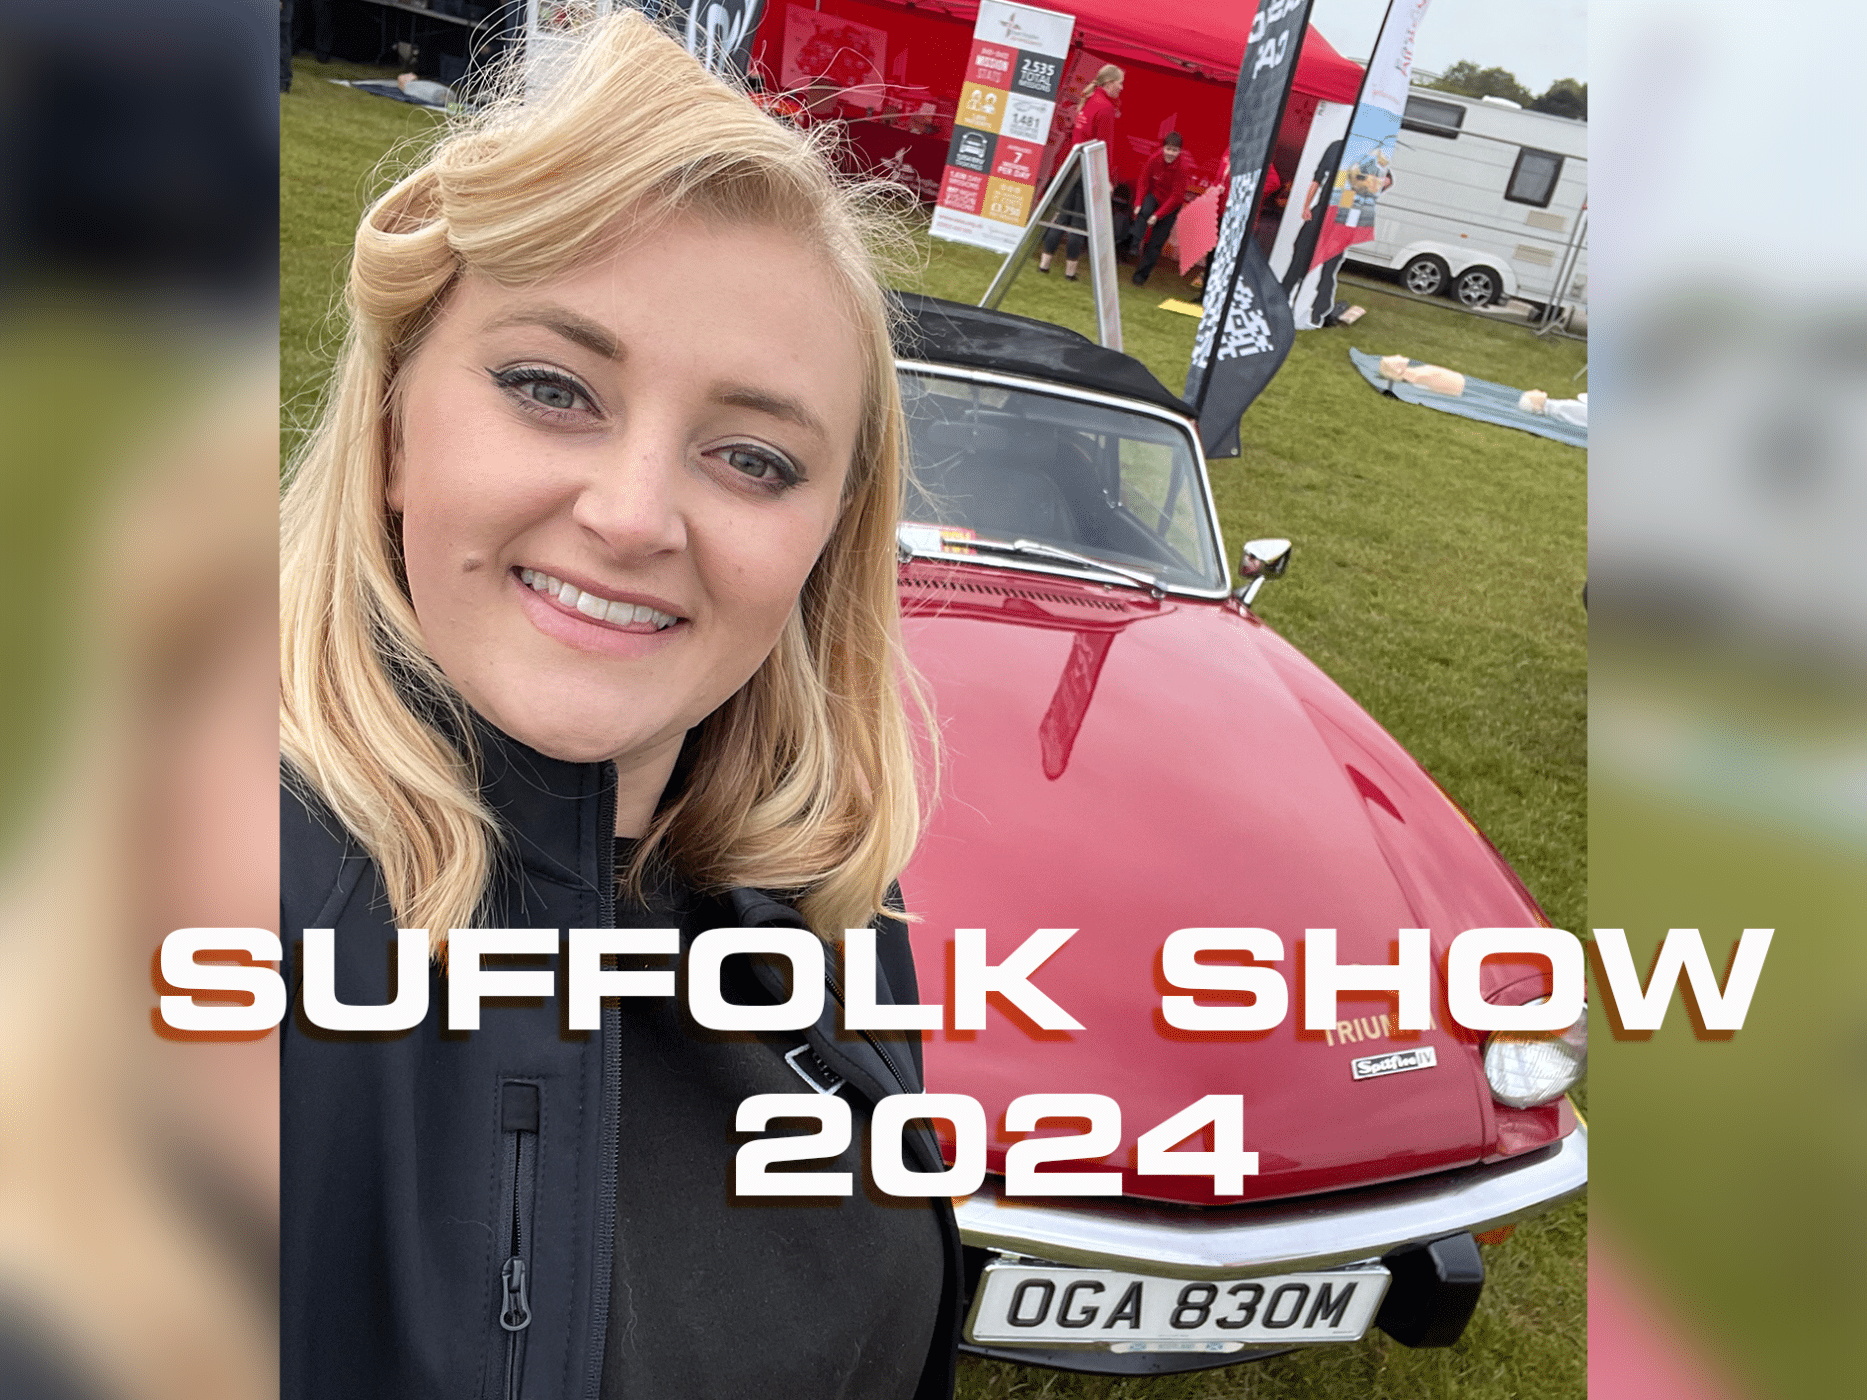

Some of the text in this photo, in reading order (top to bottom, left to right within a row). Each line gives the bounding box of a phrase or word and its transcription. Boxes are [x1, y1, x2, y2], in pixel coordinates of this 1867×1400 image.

[1020, 70, 1052, 86] TOTAL
[1014, 151, 1024, 164] 7
[997, 165, 1032, 180] PER DAY
[1006, 1278, 1359, 1330] OGA 830M
